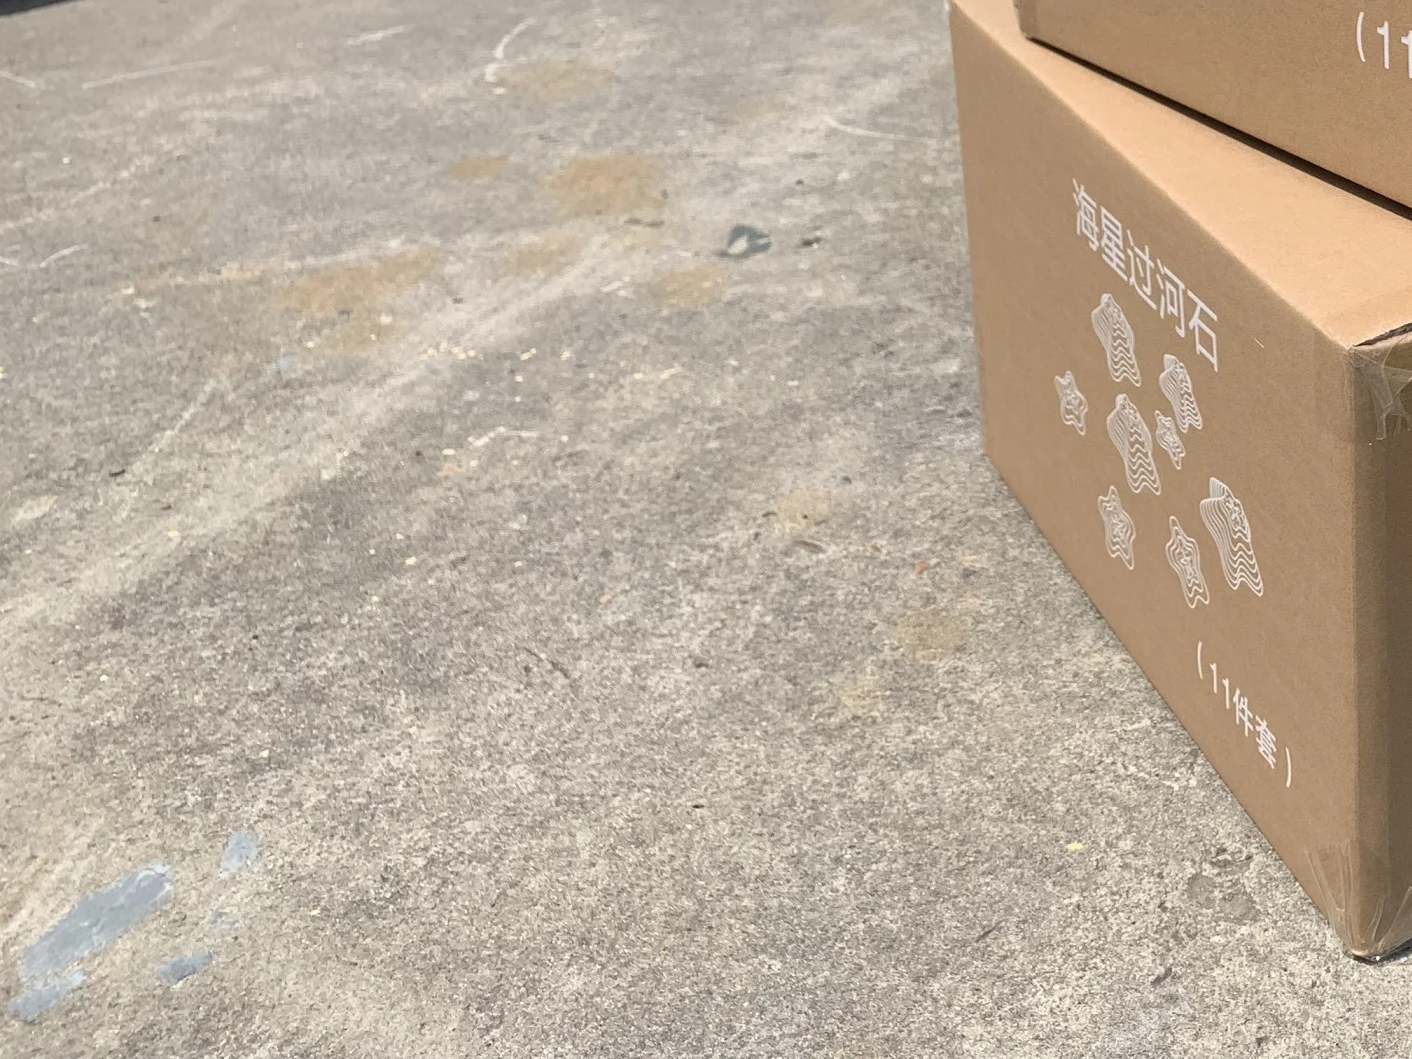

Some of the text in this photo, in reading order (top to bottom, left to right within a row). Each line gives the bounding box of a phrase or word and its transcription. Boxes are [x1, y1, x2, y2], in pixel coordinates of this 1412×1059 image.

[1072, 178, 1218, 373] 海星过河石
